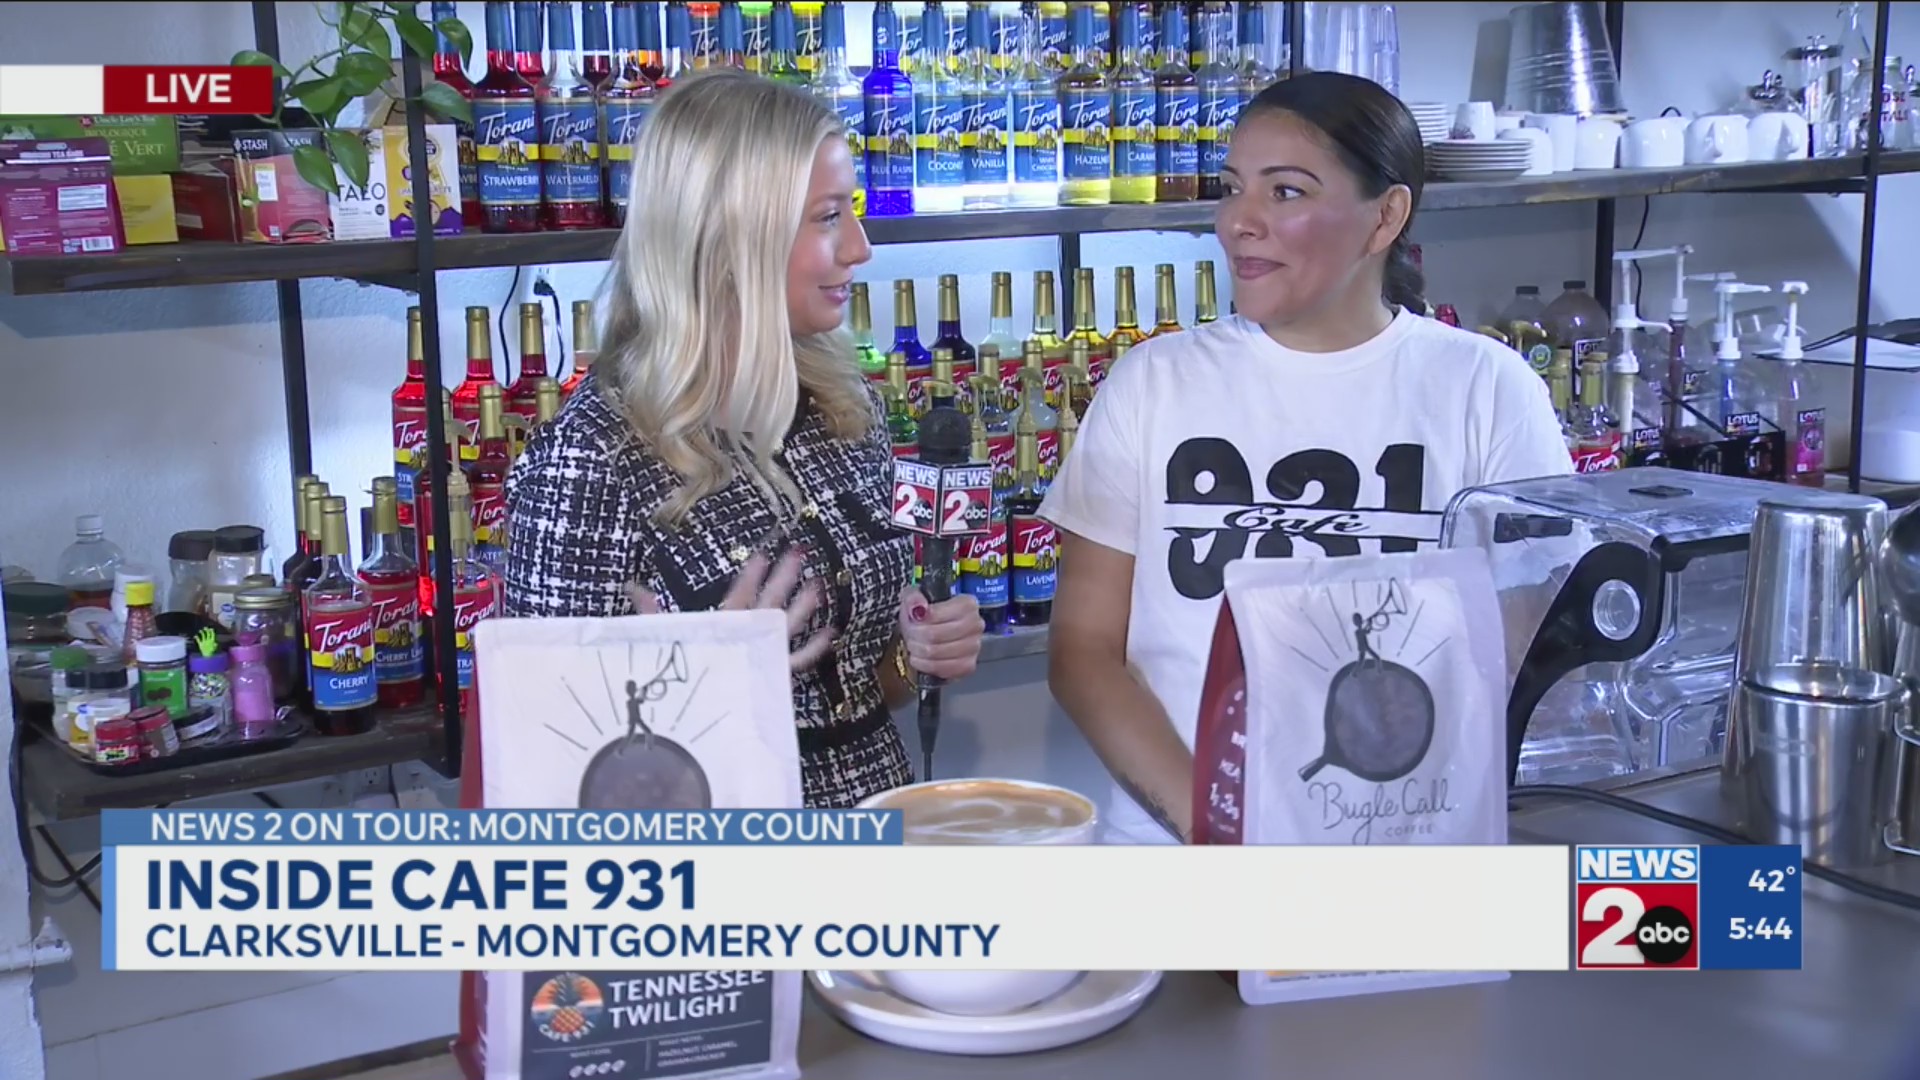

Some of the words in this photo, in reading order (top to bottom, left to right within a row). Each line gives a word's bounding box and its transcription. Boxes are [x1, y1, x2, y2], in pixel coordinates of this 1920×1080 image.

[691, 26, 719, 57] Tor
[743, 25, 770, 57] Tor
[897, 27, 921, 55] Tor
[921, 105, 963, 134] Toran
[962, 102, 1007, 132] Toran
[1069, 100, 1110, 129] Toran
[124, 141, 163, 155] VERT
[242, 139, 268, 150] STASH
[928, 161, 963, 171] COCON
[1075, 155, 1110, 165] HAZELN
[483, 174, 539, 186] STRAWBERR
[545, 174, 600, 185] WATERMELO
[1728, 413, 1758, 426] LOTUS
[897, 464, 937, 486] NEWS
[945, 470, 991, 487] NEWS
[895, 484, 918, 526] 2
[913, 503, 932, 519] abc
[943, 490, 969, 531] 2
[965, 506, 987, 519] abc
[1026, 572, 1056, 585] LAVEN
[372, 597, 417, 630] Toran
[454, 601, 495, 629] Toran
[314, 613, 372, 653] Torani
[375, 651, 408, 662] CHERRY
[330, 675, 369, 689] CHERRY
[1308, 781, 1398, 845] Bugle
[1402, 778, 1453, 816] Call
[1384, 823, 1433, 838] COFFEE
[608, 970, 767, 1003] TENNESSEE
[608, 991, 743, 1028] TWILIGHT
